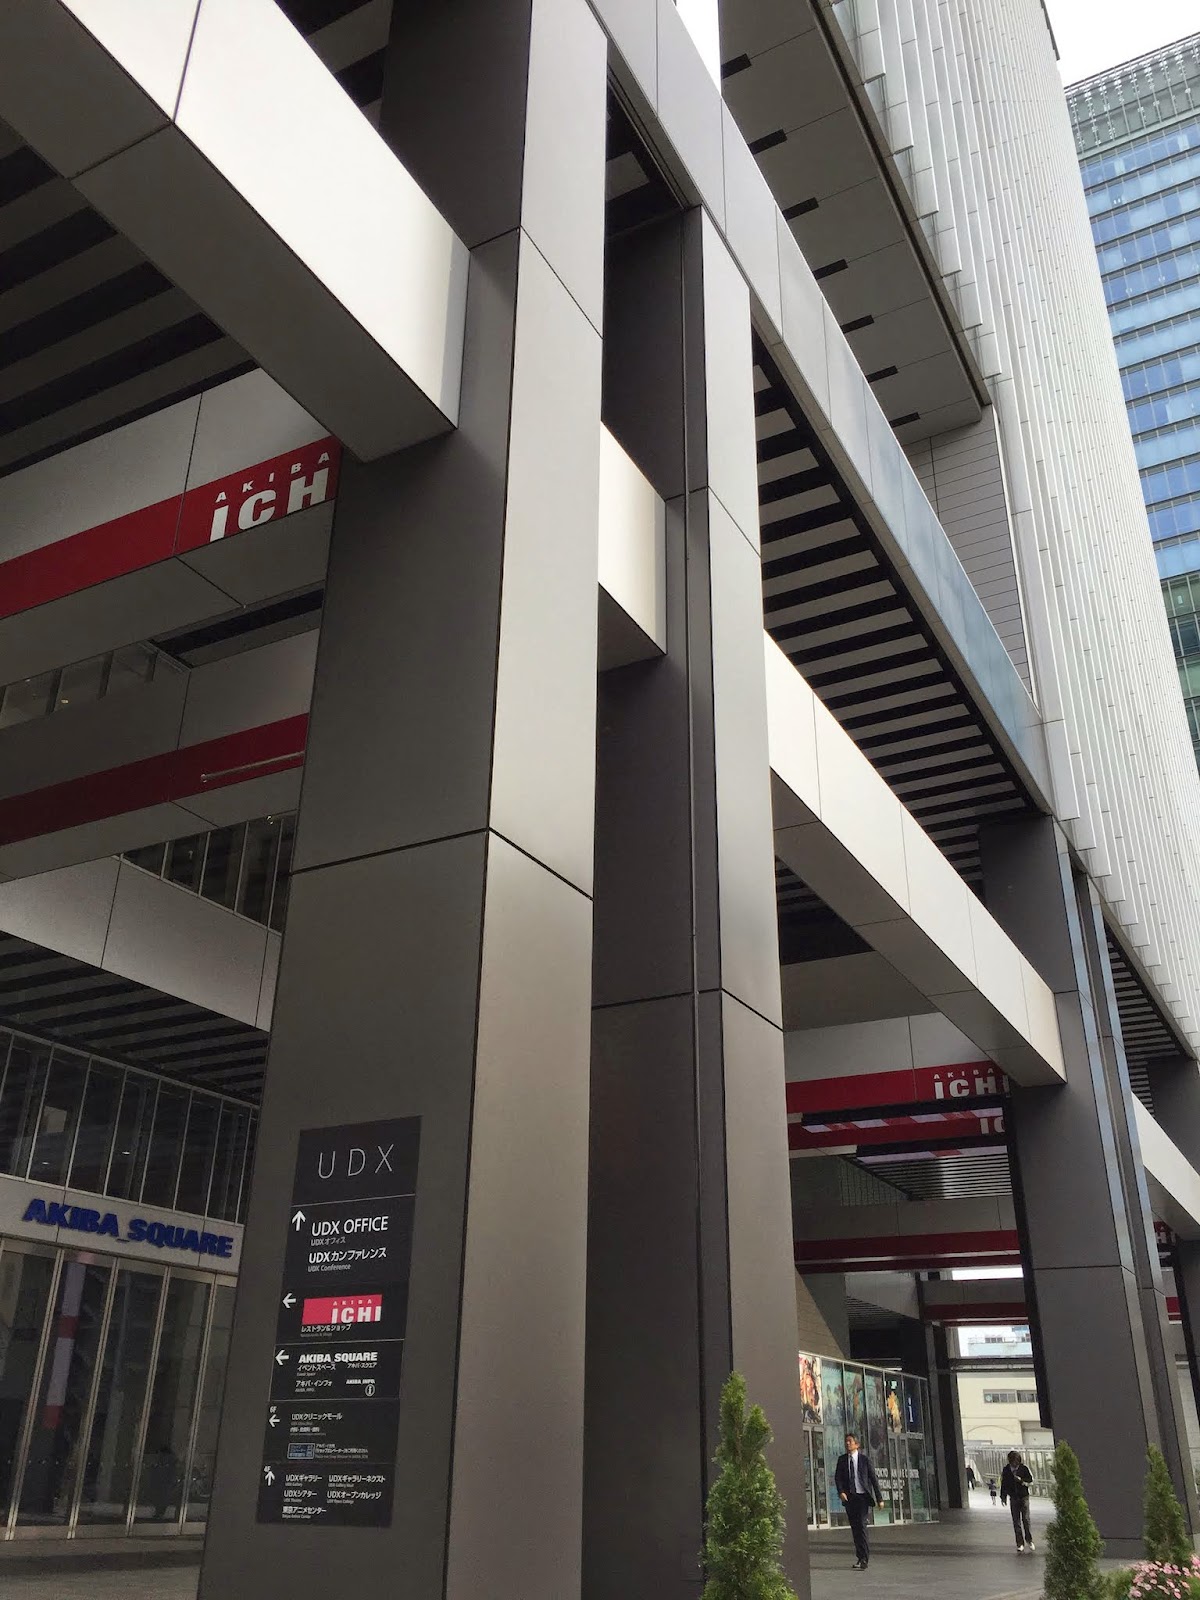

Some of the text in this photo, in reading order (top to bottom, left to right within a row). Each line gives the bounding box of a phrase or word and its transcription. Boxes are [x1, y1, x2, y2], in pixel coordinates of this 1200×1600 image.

[215, 452, 330, 503] AKIBA
[933, 1067, 994, 1080] AKIBA
[317, 1143, 394, 1179] UDX
[311, 1215, 389, 1237] UDX OFFICE
[308, 1247, 387, 1264] UDXカンファレンス
[331, 1305, 382, 1324] ICHI
[269, 1405, 277, 1414] 6F
